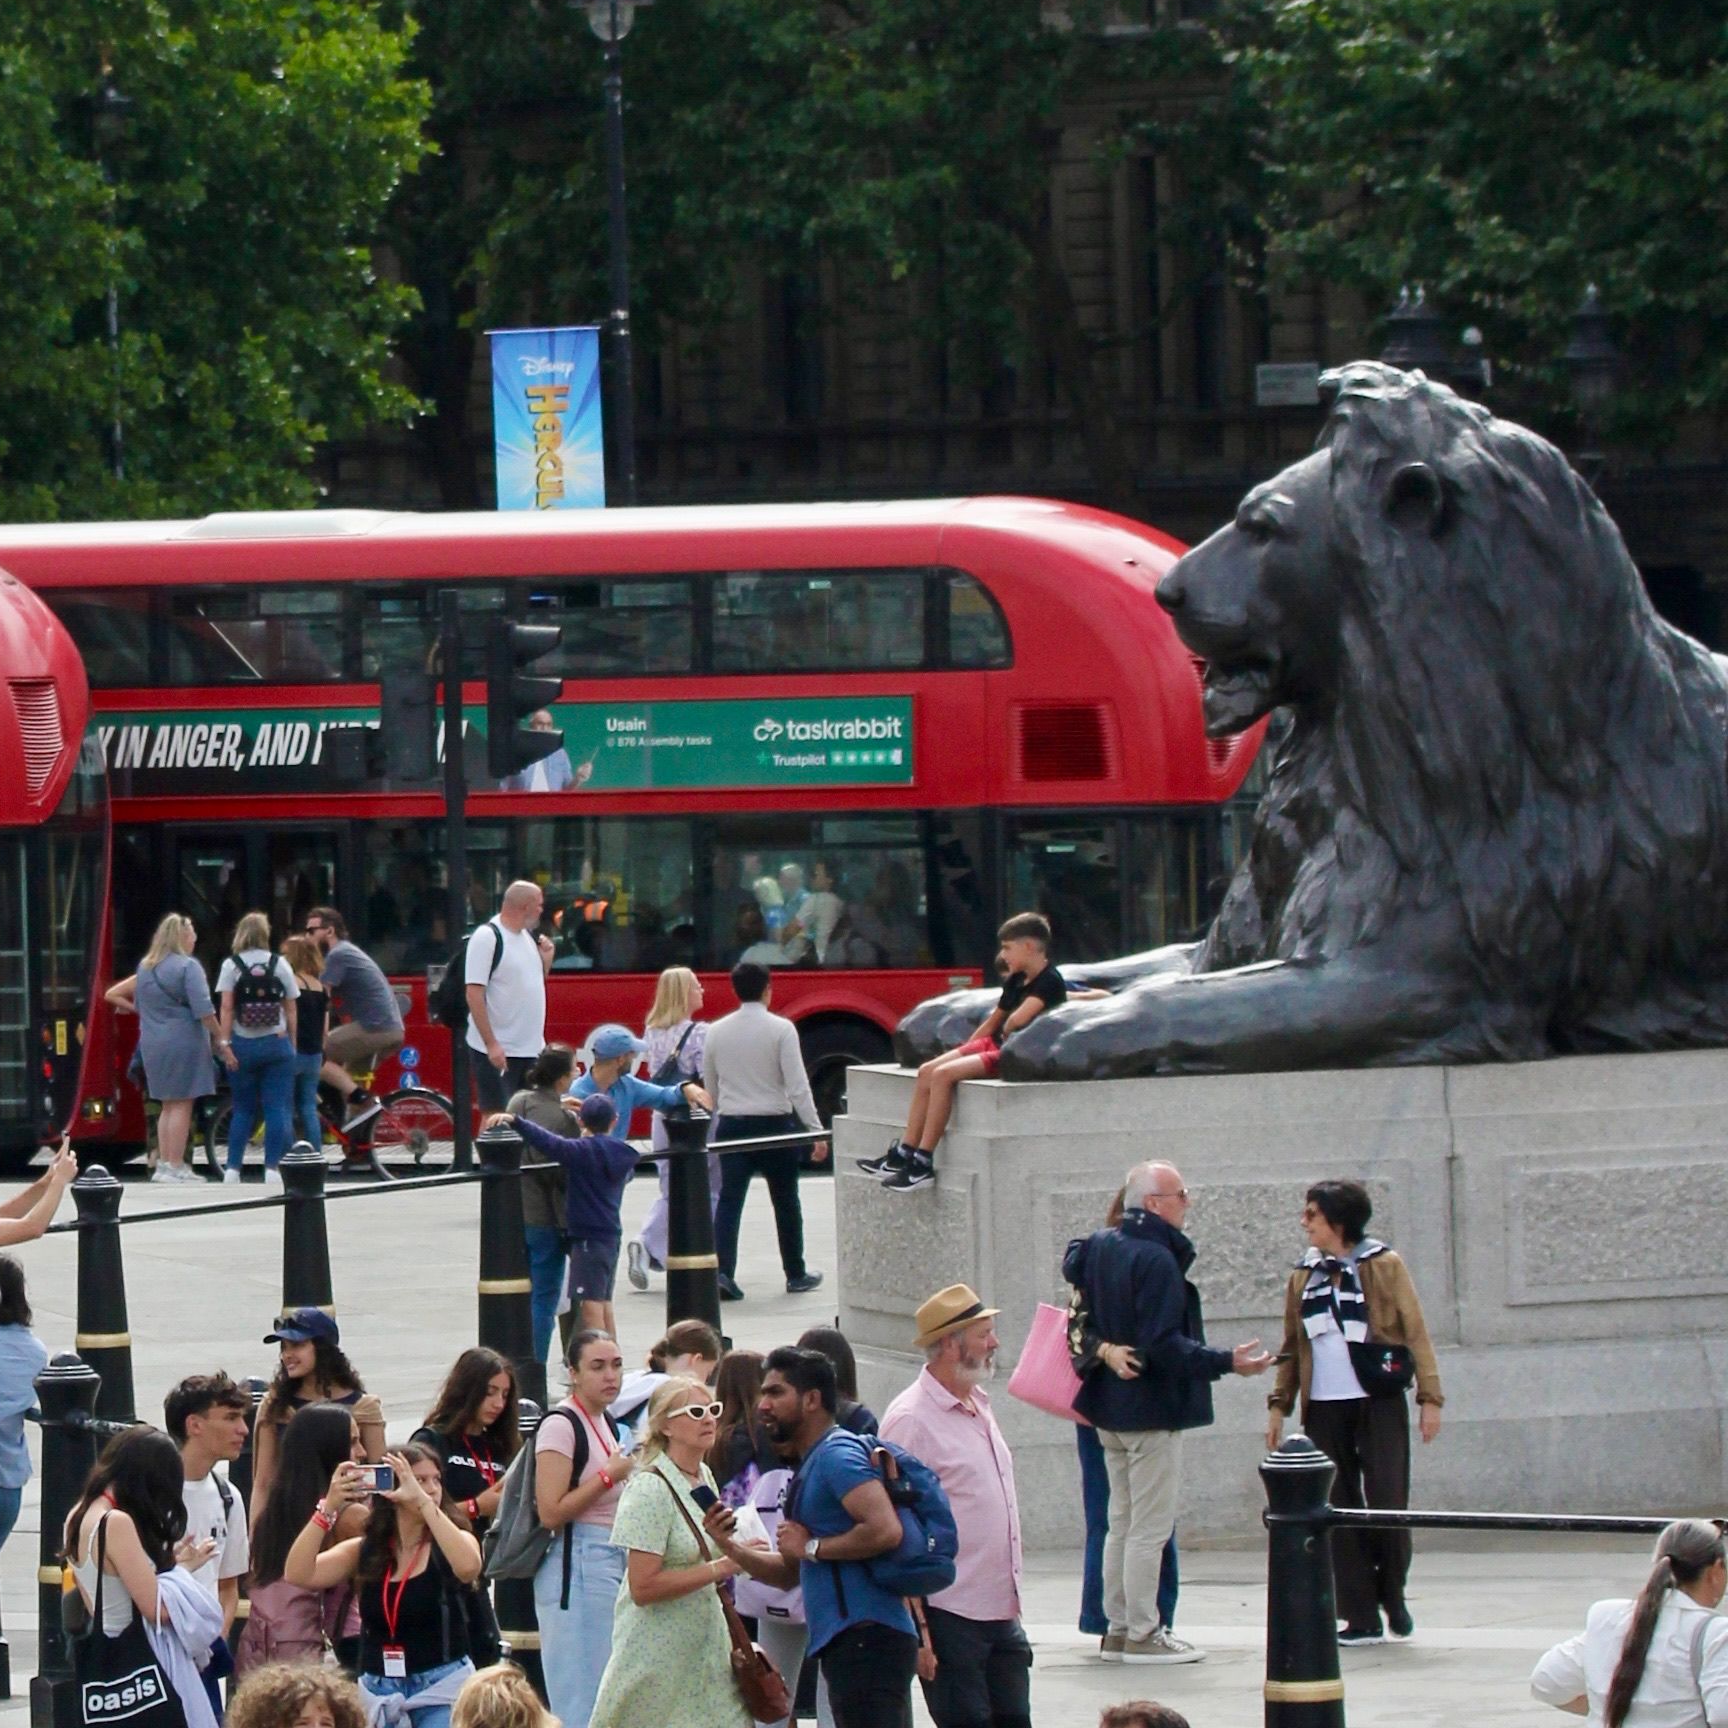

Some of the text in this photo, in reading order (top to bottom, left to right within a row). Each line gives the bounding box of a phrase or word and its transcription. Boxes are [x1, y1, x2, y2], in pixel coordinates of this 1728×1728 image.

[606, 718, 647, 732] Usain
[786, 716, 902, 741] taskrabbit
[114, 726, 149, 769] IN
[147, 724, 245, 772] ANGER,
[249, 722, 317, 767] AND
[686, 736, 712, 746] tasks
[772, 752, 827, 767] Trustpilot
[88, 1677, 157, 1712] oasis
